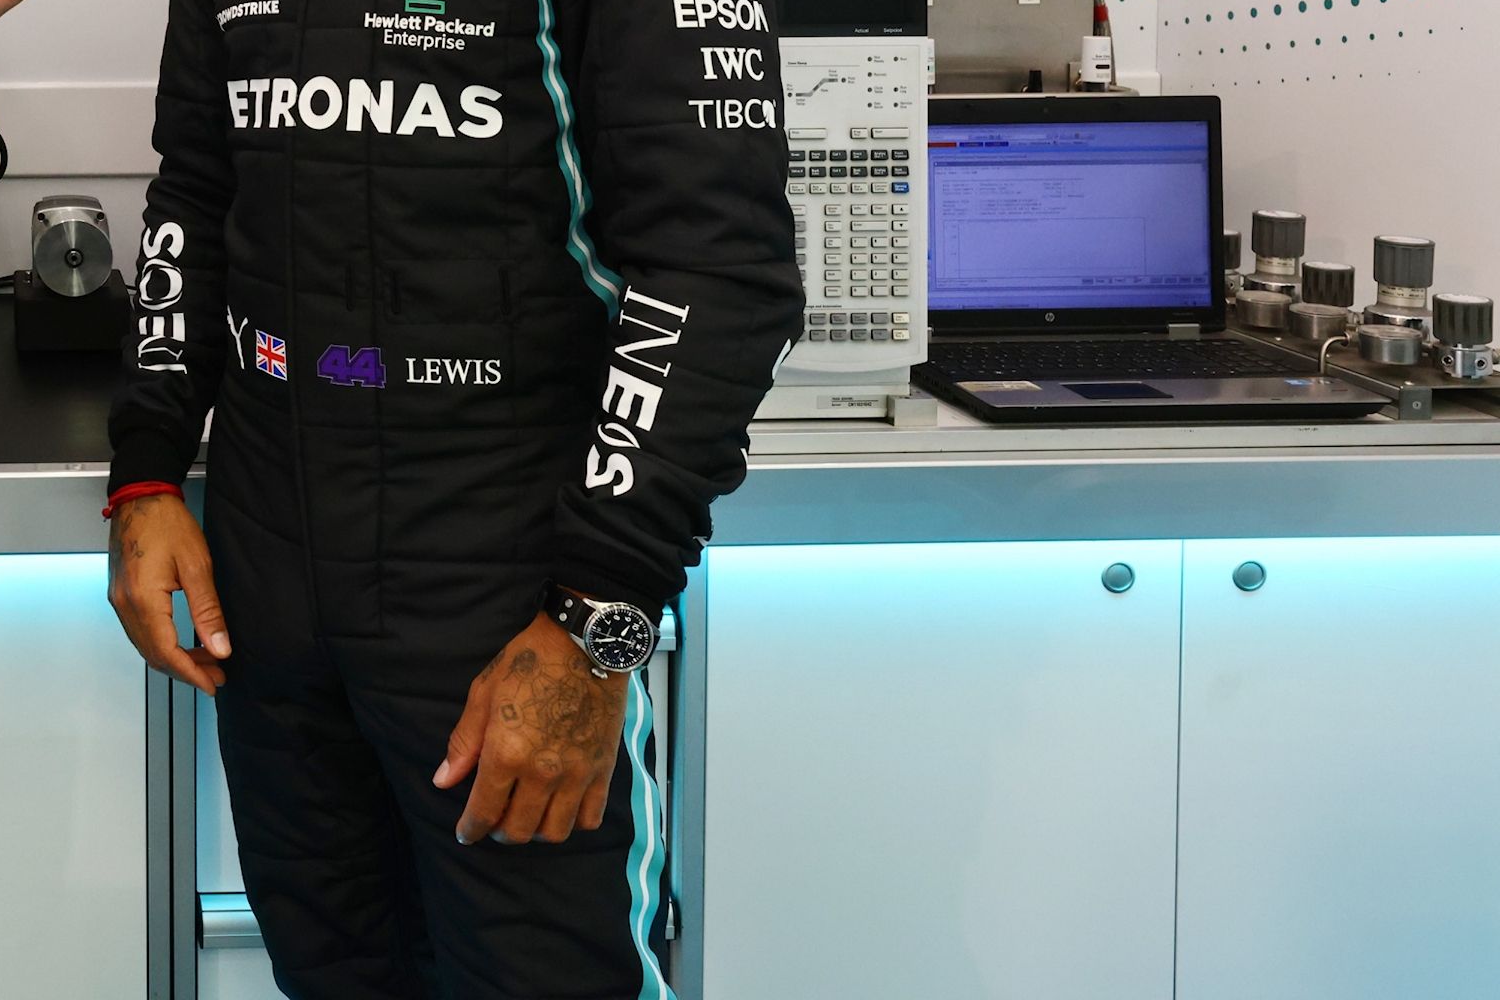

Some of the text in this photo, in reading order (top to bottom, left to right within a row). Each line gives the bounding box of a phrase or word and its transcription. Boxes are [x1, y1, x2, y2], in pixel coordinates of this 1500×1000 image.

[364, 13, 495, 37] Hewlett Packard
[383, 29, 465, 51] Enterprise
[700, 47, 764, 81] IWC
[227, 75, 503, 139] ETRONAS
[138, 221, 187, 374] INEOS
[316, 344, 387, 389] 44
[406, 357, 502, 385] LEWIS
[585, 285, 690, 496] INEOS
